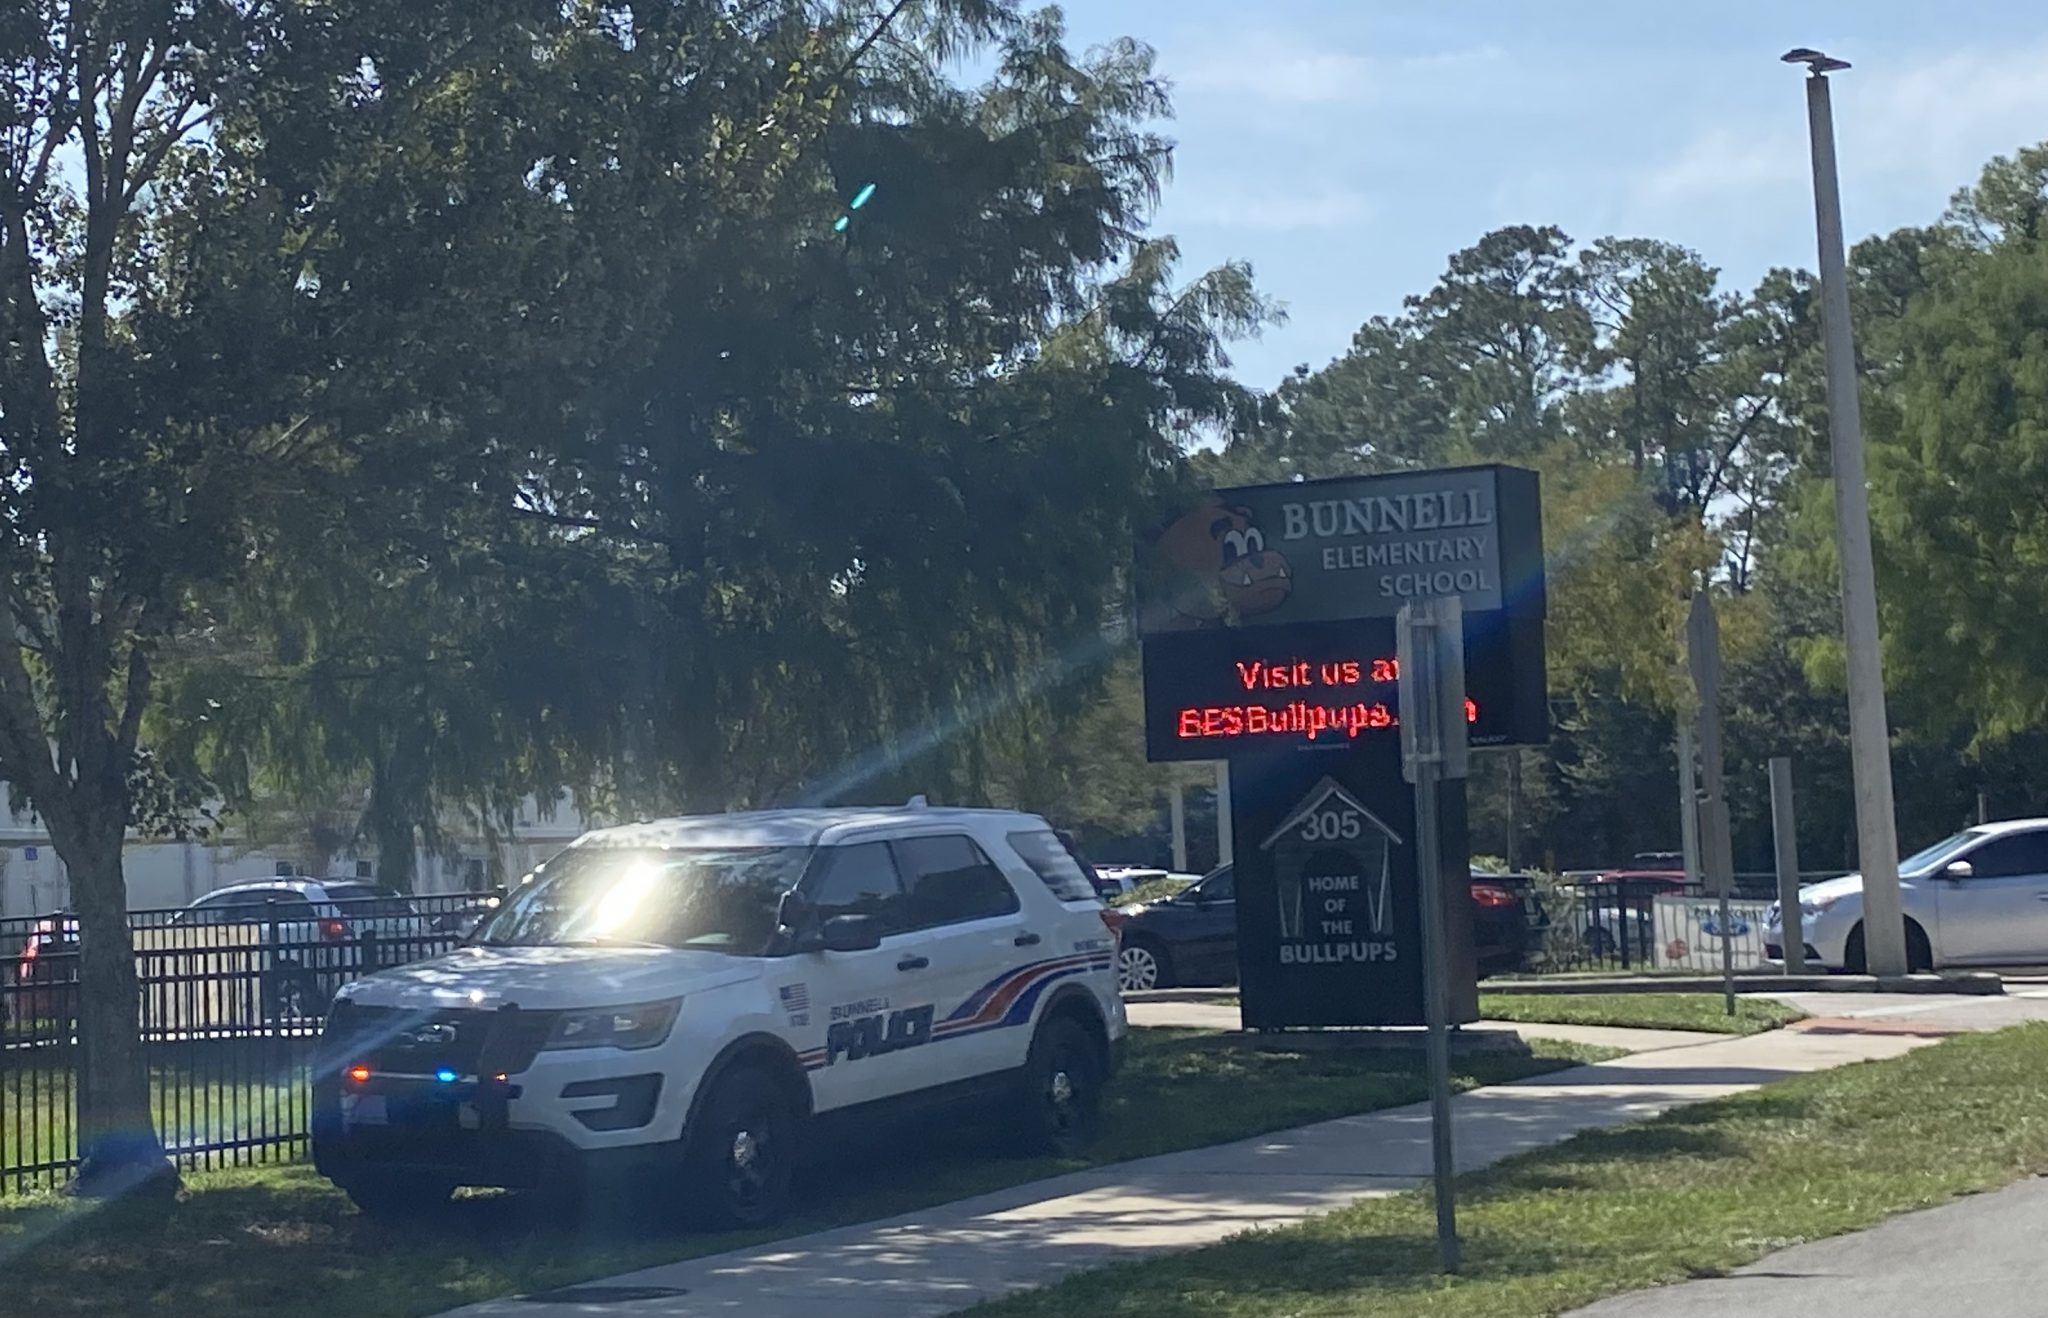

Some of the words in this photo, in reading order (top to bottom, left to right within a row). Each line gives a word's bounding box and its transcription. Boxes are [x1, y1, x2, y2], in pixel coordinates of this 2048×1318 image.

[1282, 489, 1492, 540] BUNNELL
[1322, 536, 1488, 570] ELEMENTARY
[1380, 569, 1492, 597] SCHOOL
[1236, 657, 1312, 690] Visit
[1321, 661, 1360, 686] us
[1301, 810, 1361, 841] 305
[1308, 875, 1360, 892] HOME
[1324, 898, 1347, 913] OF
[1321, 920, 1353, 935] THE
[1279, 942, 1398, 964] BULLPUPS
